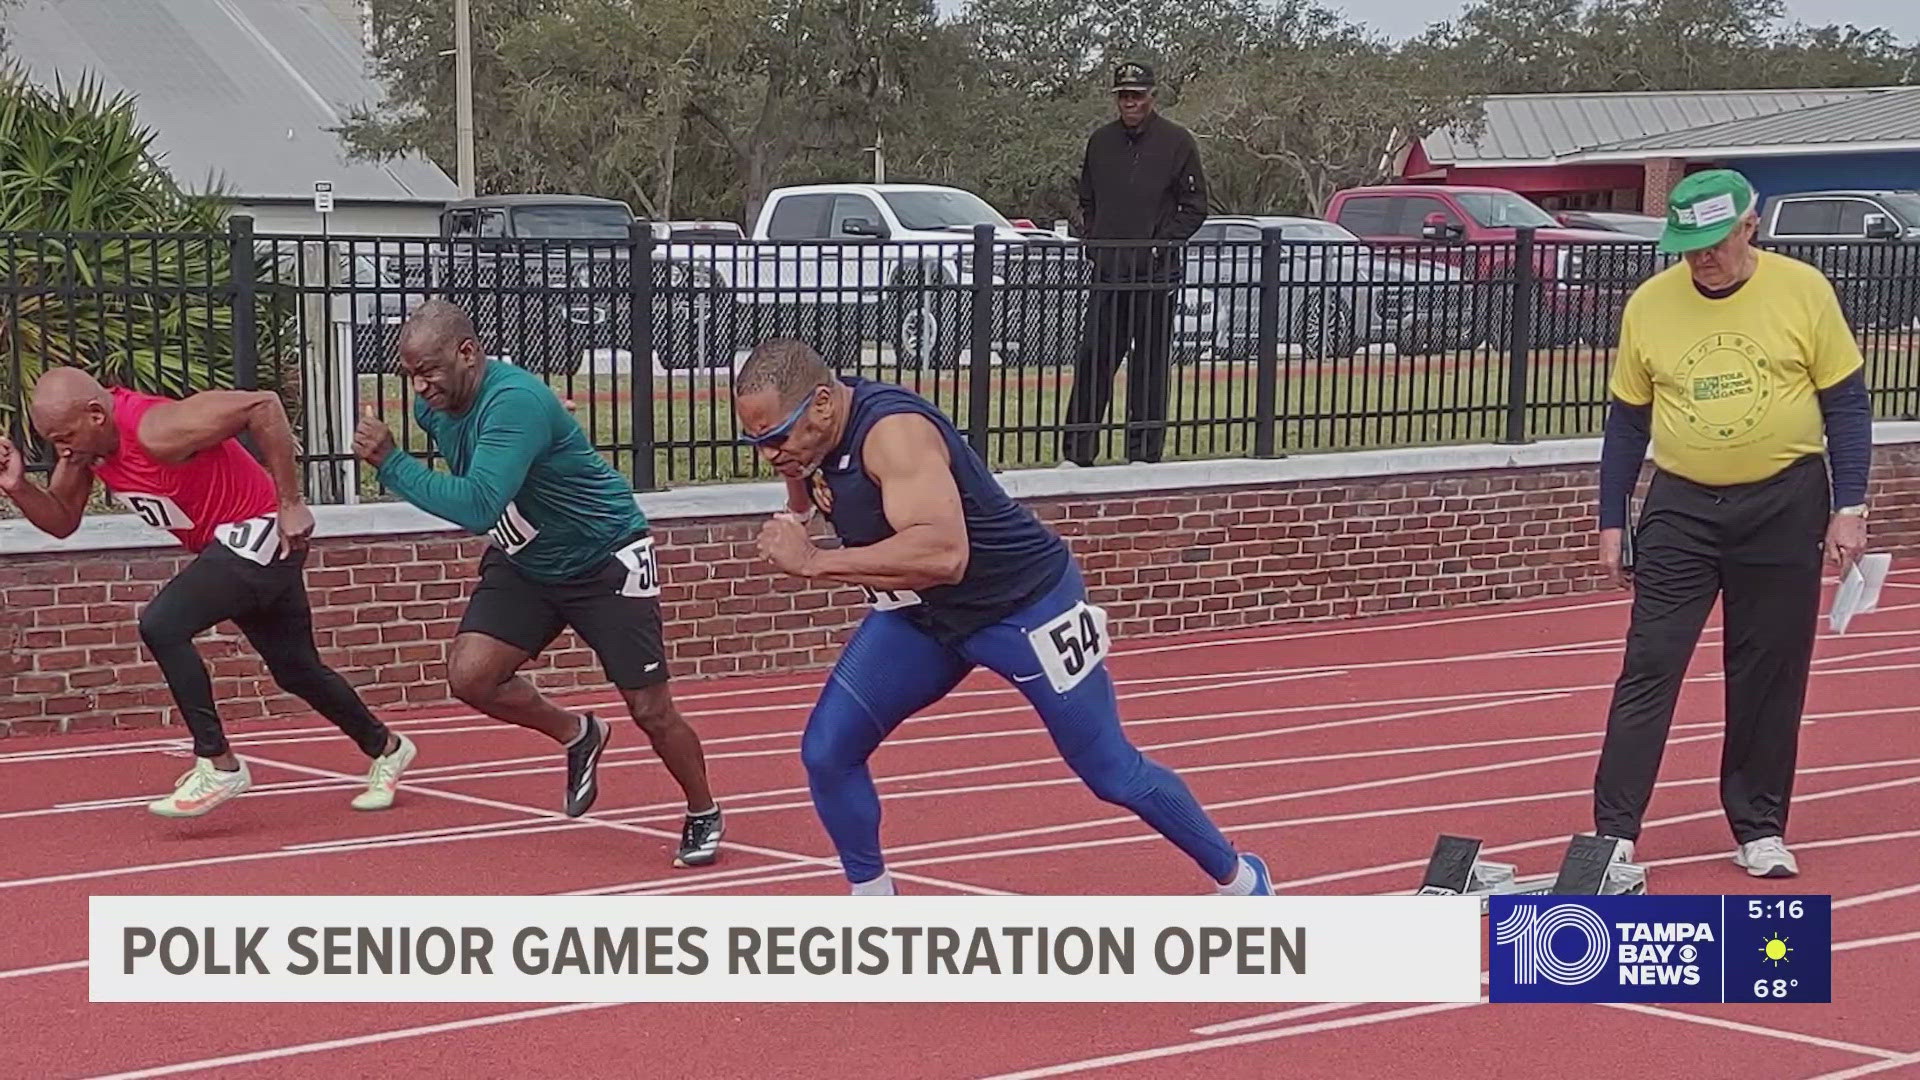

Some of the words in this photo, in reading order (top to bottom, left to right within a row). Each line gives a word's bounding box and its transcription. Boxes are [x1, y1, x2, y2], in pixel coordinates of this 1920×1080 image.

[128, 497, 172, 527] 57
[228, 517, 275, 553] 57
[1048, 608, 1099, 676] 54
